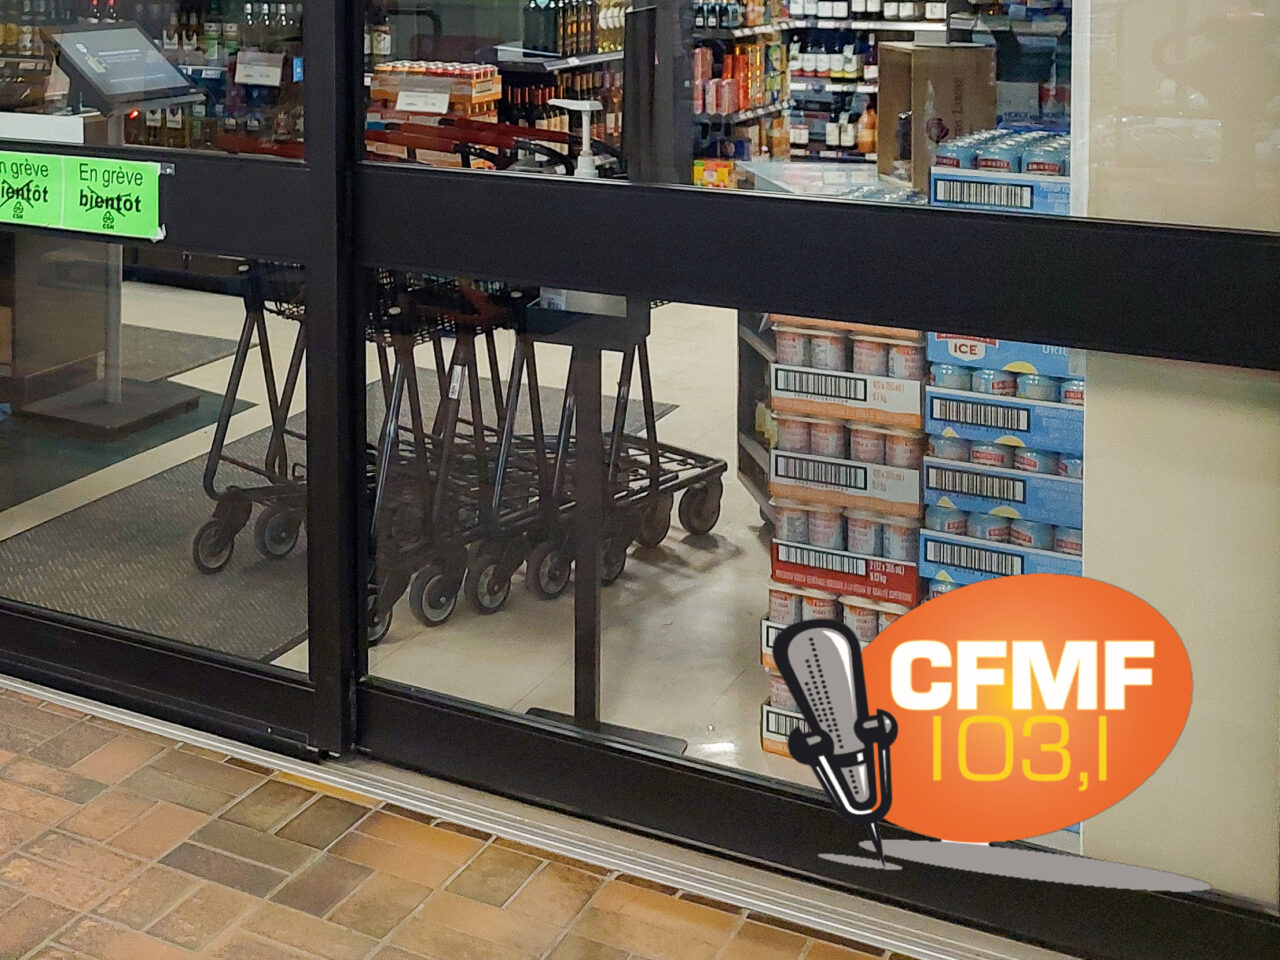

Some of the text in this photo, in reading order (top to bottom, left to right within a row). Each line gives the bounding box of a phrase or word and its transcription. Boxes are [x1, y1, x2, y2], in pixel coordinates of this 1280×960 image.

[10, 158, 49, 180] grève
[79, 163, 143, 188] En grève
[79, 189, 142, 213] bientôt
[954, 343, 978, 355] ICE
